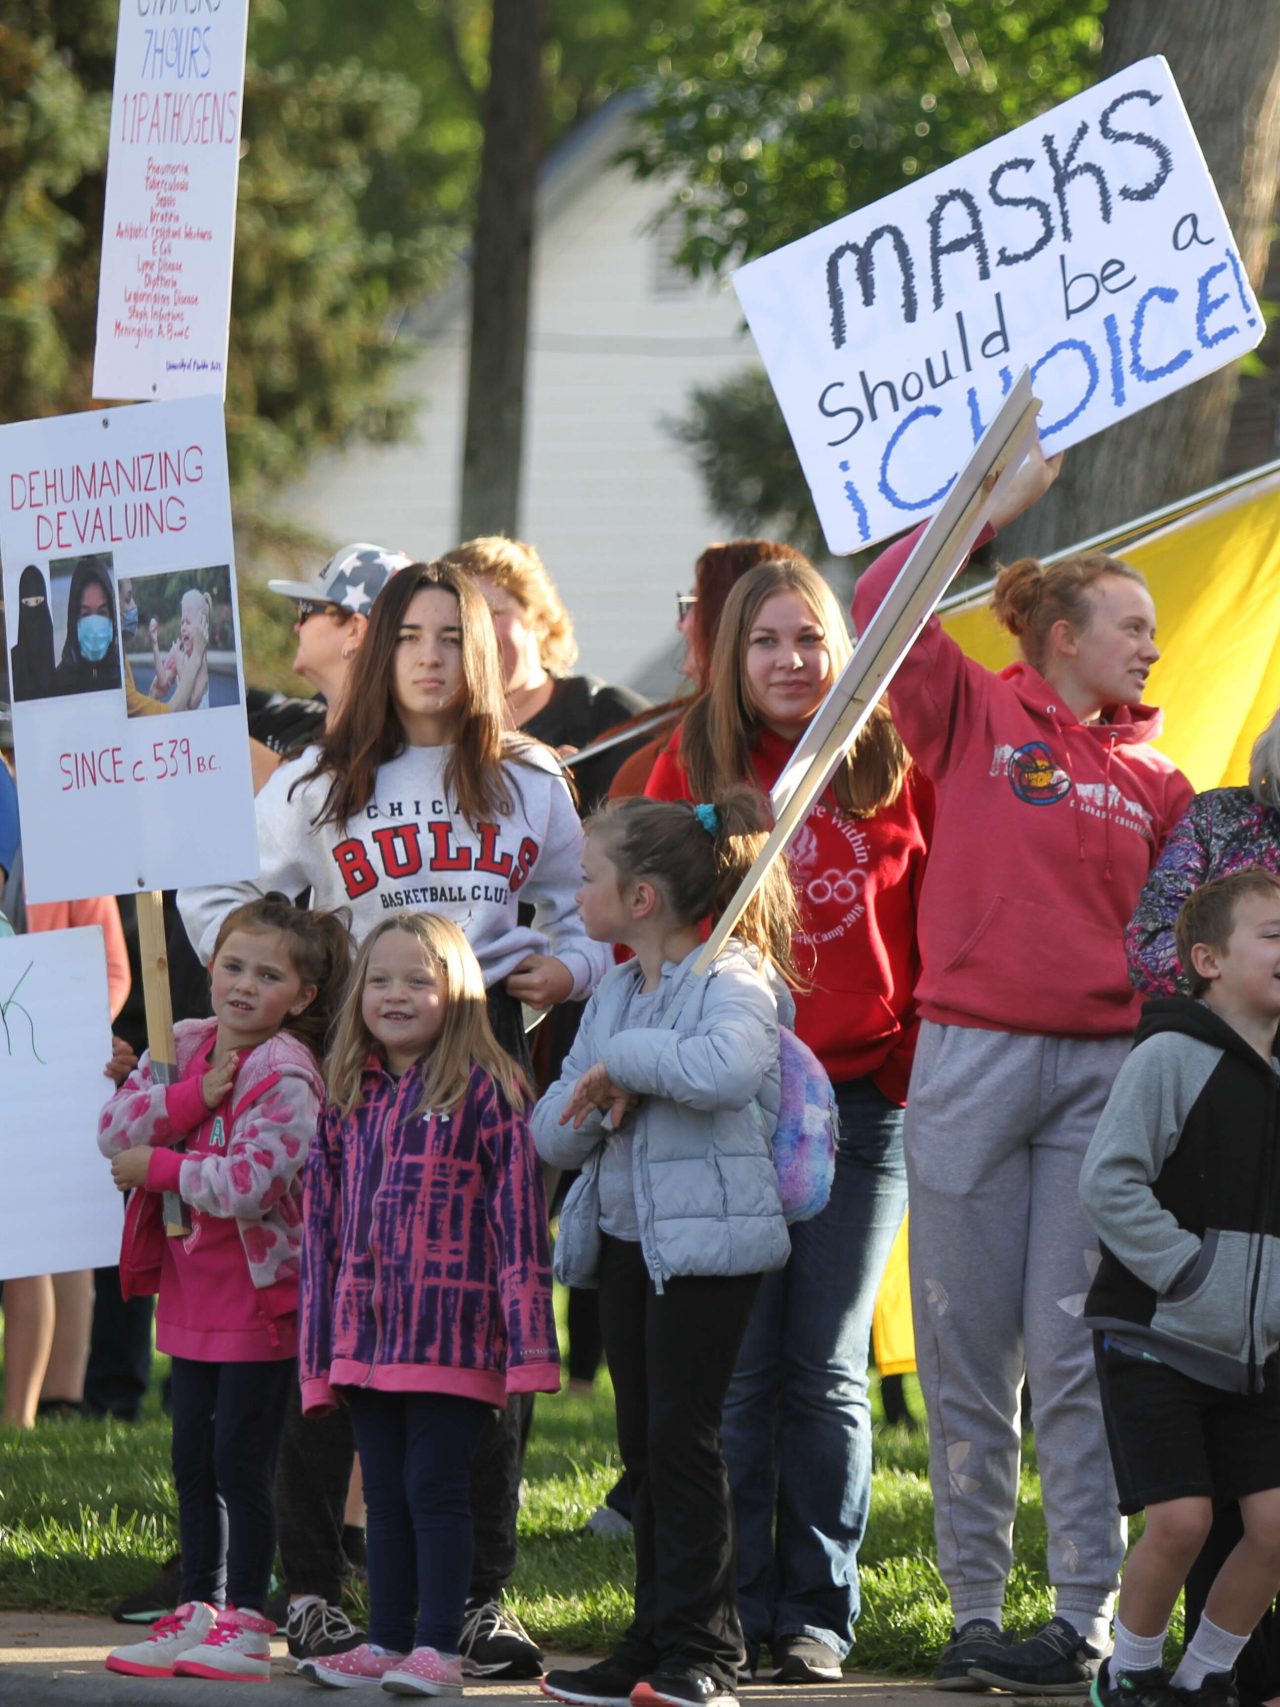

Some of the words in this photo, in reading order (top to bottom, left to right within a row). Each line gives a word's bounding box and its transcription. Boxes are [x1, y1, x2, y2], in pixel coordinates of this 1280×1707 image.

[826, 89, 1173, 350] MASKS
[1060, 253, 1137, 321] be
[1171, 213, 1215, 251] a
[10, 445, 204, 512] DEHUMANIZING
[36, 496, 188, 551] DEVALUING
[59, 747, 125, 791] SINCE
[153, 738, 192, 780] 539
[1069, 799, 1112, 820] CLORAD
[332, 820, 540, 900] BULLS
[380, 885, 467, 910] BASKETBALL
[811, 926, 845, 945] Camp
[842, 903, 866, 929] 2018
